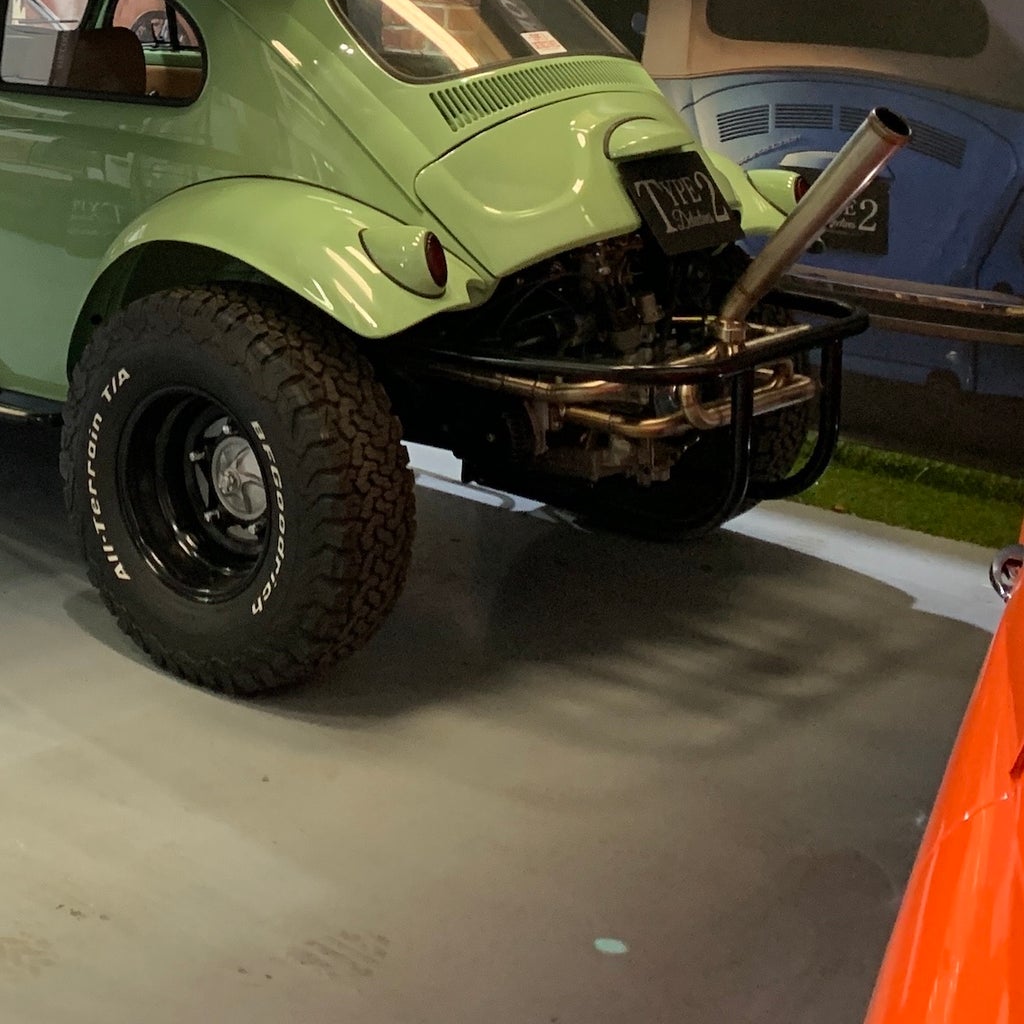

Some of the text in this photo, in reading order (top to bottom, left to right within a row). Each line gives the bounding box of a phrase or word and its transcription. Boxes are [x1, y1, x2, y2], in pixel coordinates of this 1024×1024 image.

[633, 170, 731, 234] TYPE 2
[101, 367, 131, 403] T/A
[87, 412, 131, 581] All-Terrain
